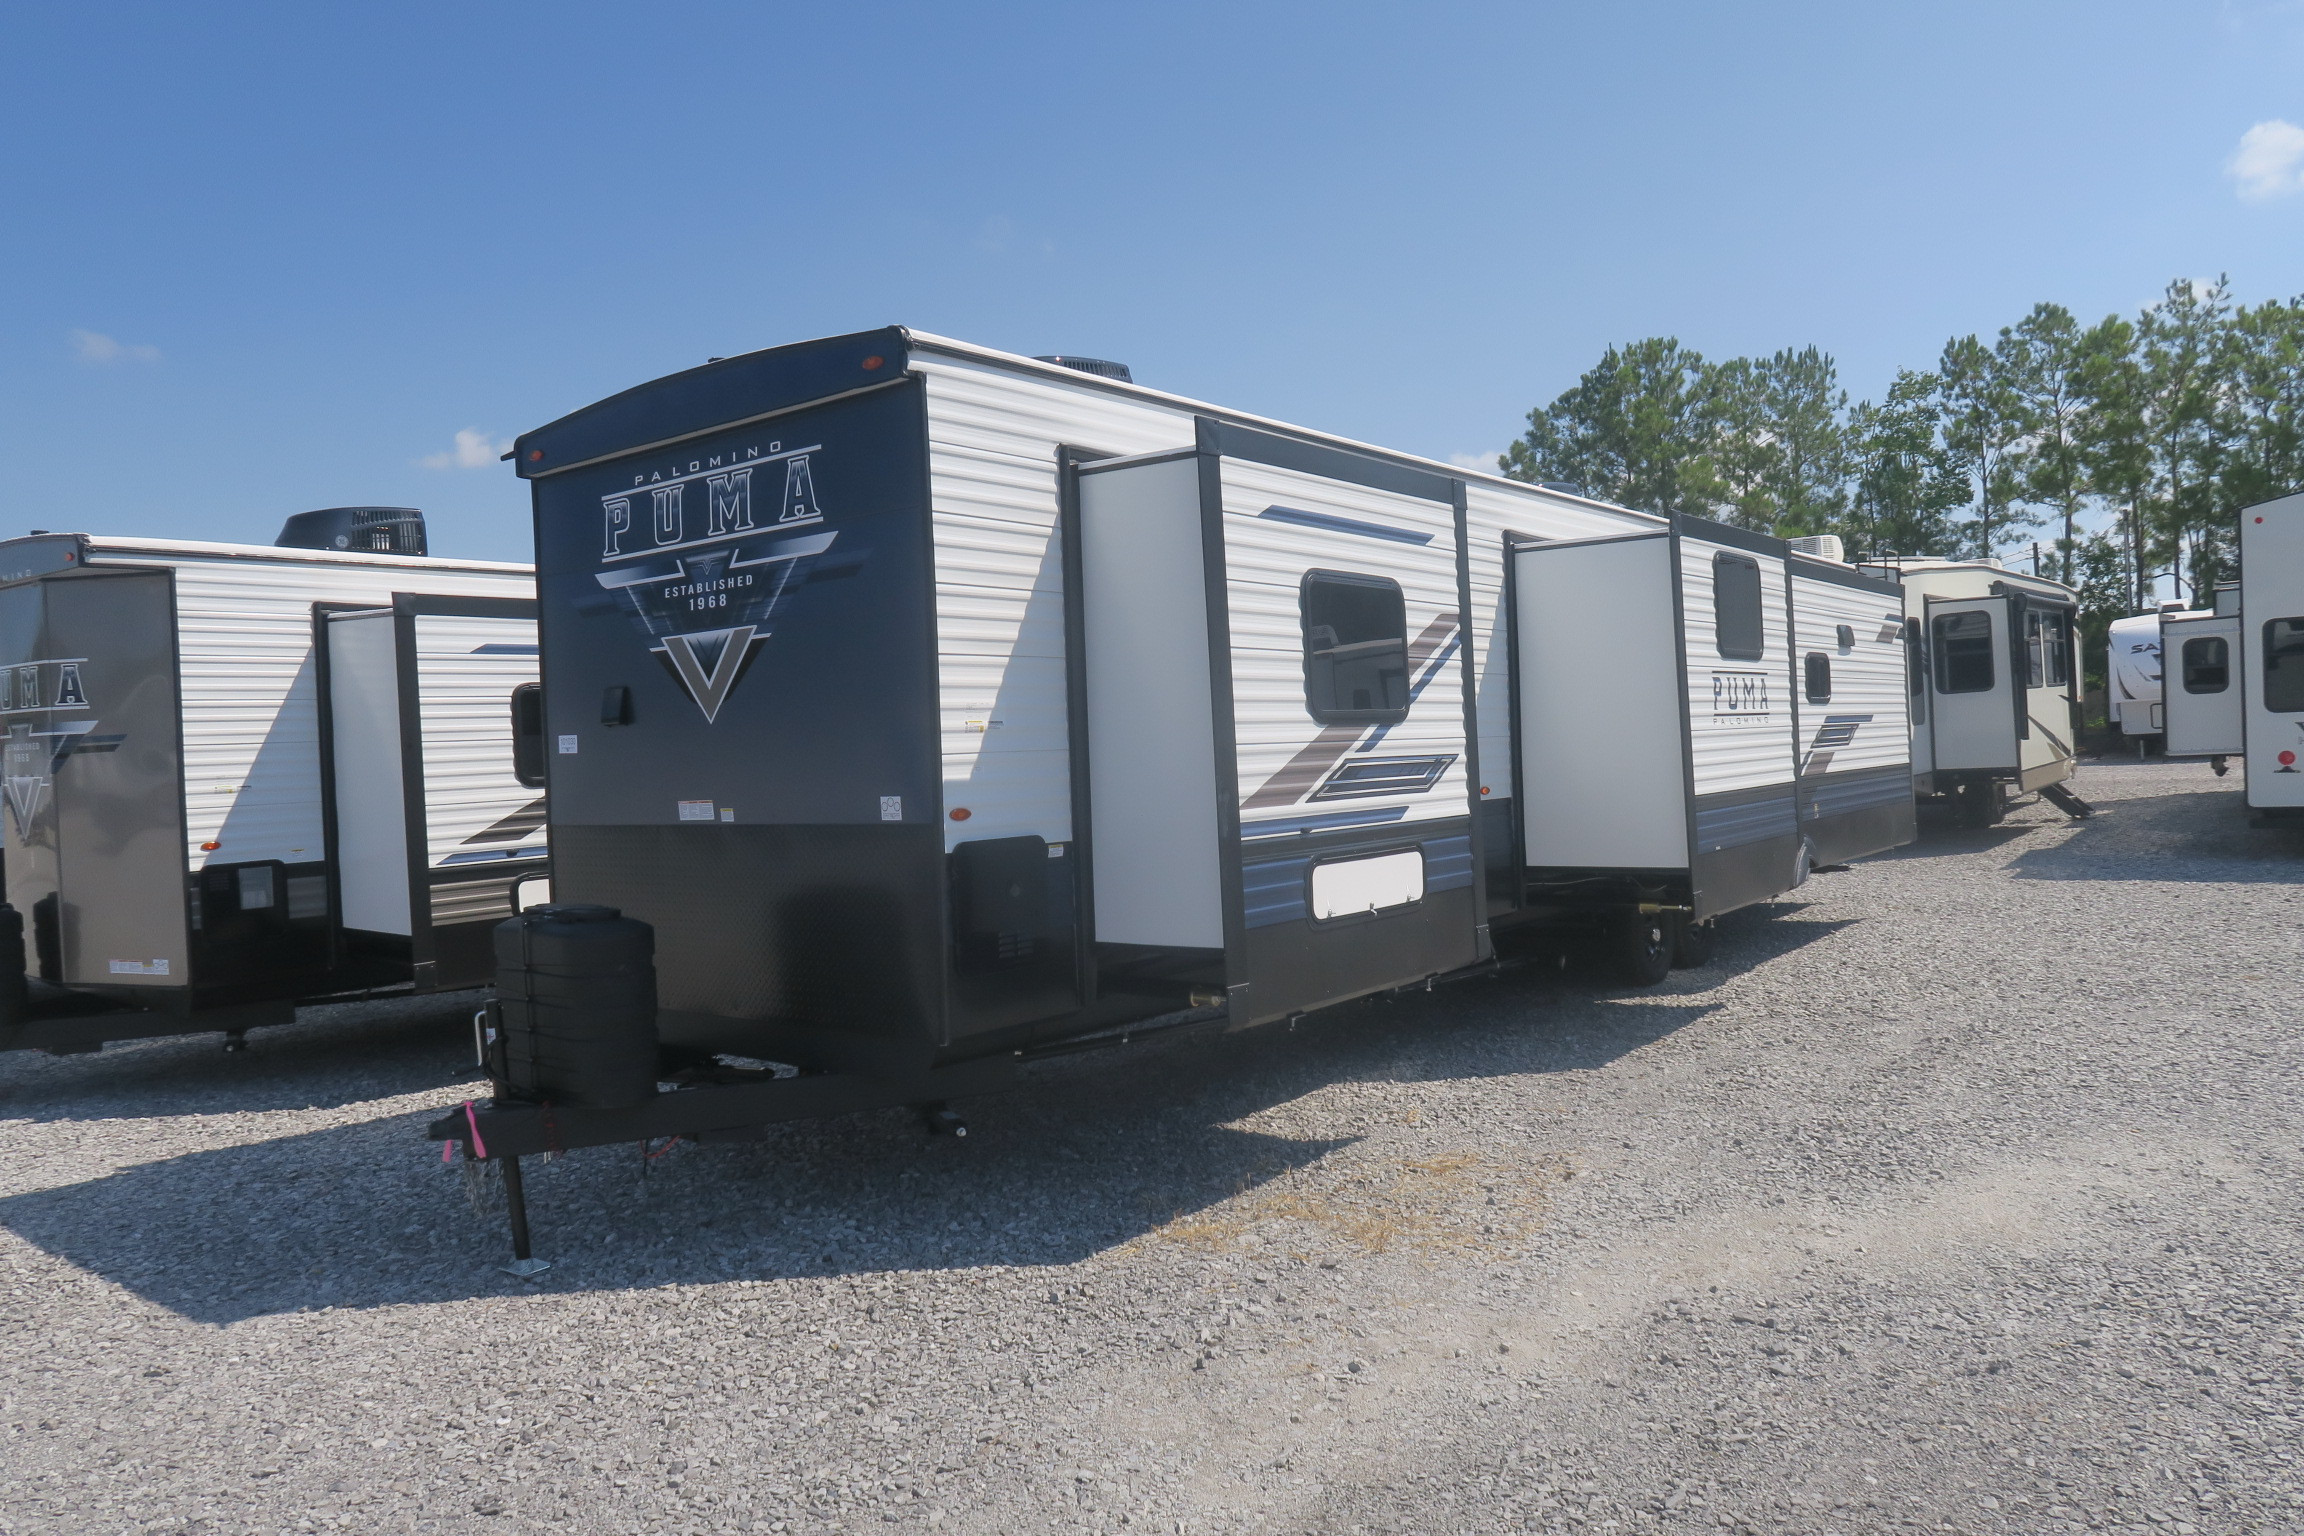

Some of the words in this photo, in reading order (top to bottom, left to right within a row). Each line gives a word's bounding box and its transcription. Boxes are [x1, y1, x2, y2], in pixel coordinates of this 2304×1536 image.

[635, 441, 781, 486] PALOMINO
[603, 455, 822, 557] PUMA
[2, 569, 32, 581] MINO
[664, 574, 754, 598] ESTABLISHED
[689, 594, 727, 611] 1968
[2130, 643, 2161, 654] SA
[0, 664, 88, 710] UMA
[1712, 677, 1769, 710] PUMA
[1713, 717, 1769, 725] PALOMINO
